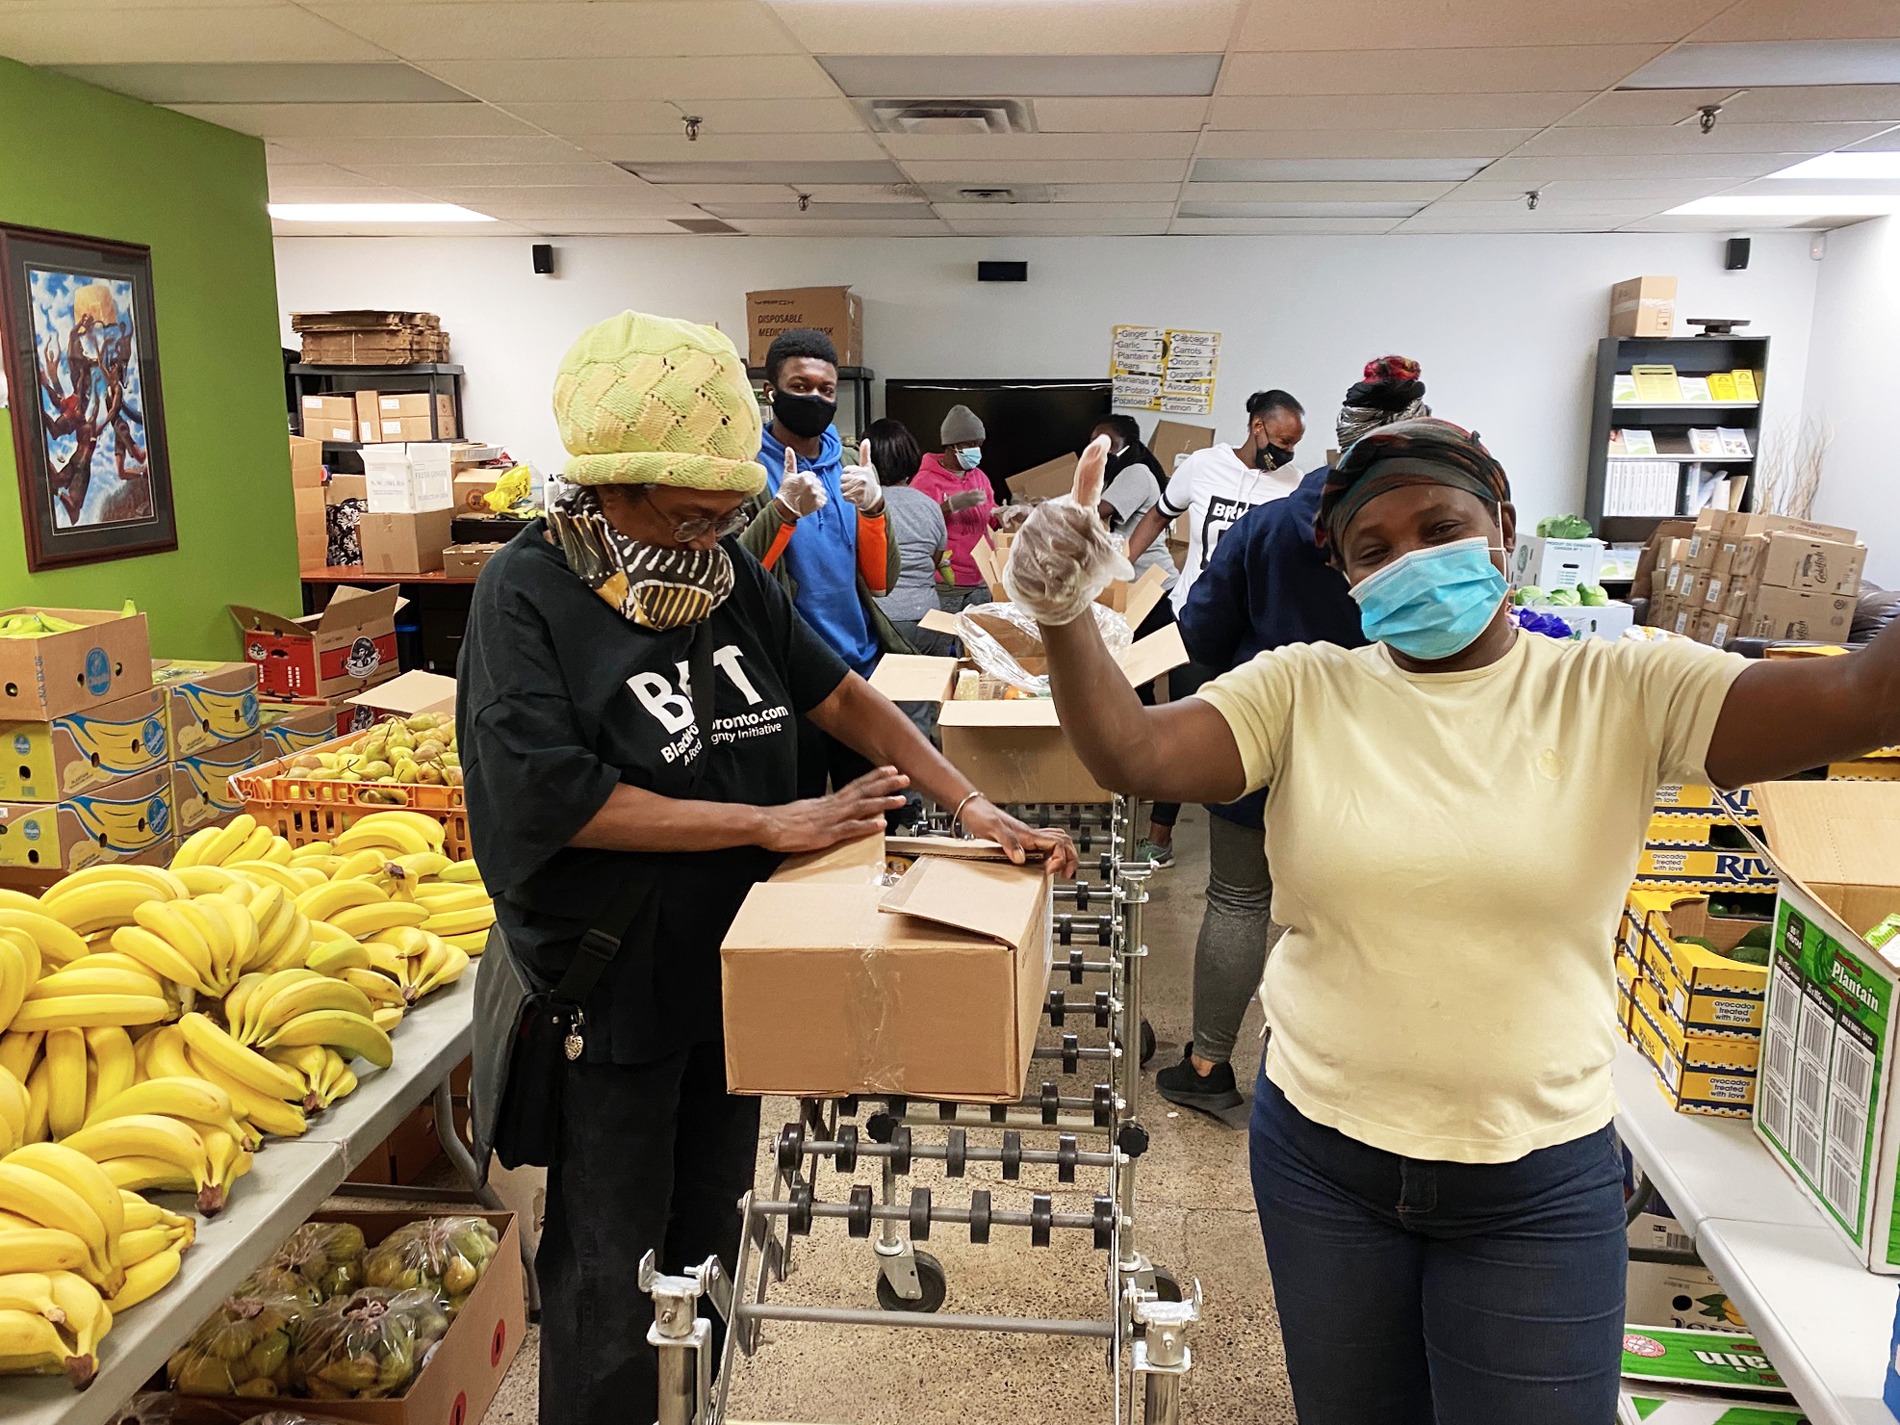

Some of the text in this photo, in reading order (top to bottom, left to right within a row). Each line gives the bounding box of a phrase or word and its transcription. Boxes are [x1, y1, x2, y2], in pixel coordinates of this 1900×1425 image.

[758, 314, 803, 324] DISPOSABLE
[1121, 330, 1148, 339] Ginger
[1173, 334, 1209, 344] Cabbage
[1117, 341, 1140, 349] Garlic
[1173, 347, 1202, 355] Carrots
[1117, 352, 1149, 360] Plantain
[1117, 362, 1140, 371] Pears
[1171, 358, 1199, 366] Onions
[1169, 371, 1203, 380] Oranges
[1116, 375, 1150, 386] Bananas
[1125, 386, 1151, 394] Potato
[1167, 383, 1201, 392] Avocado
[1113, 396, 1147, 406] Potatoes
[1165, 404, 1191, 412] Lemon
[738, 723, 782, 739] Initiative
[1716, 855, 1775, 881] RIV
[1831, 960, 1879, 1013] Plantain
[1714, 1001, 1756, 1010] avocados
[1719, 1007, 1749, 1016] treated
[1733, 1015, 1751, 1023] love
[1709, 1077, 1751, 1086] avocados
[1714, 1084, 1744, 1093] treated
[1710, 1090, 1746, 1100] with love
